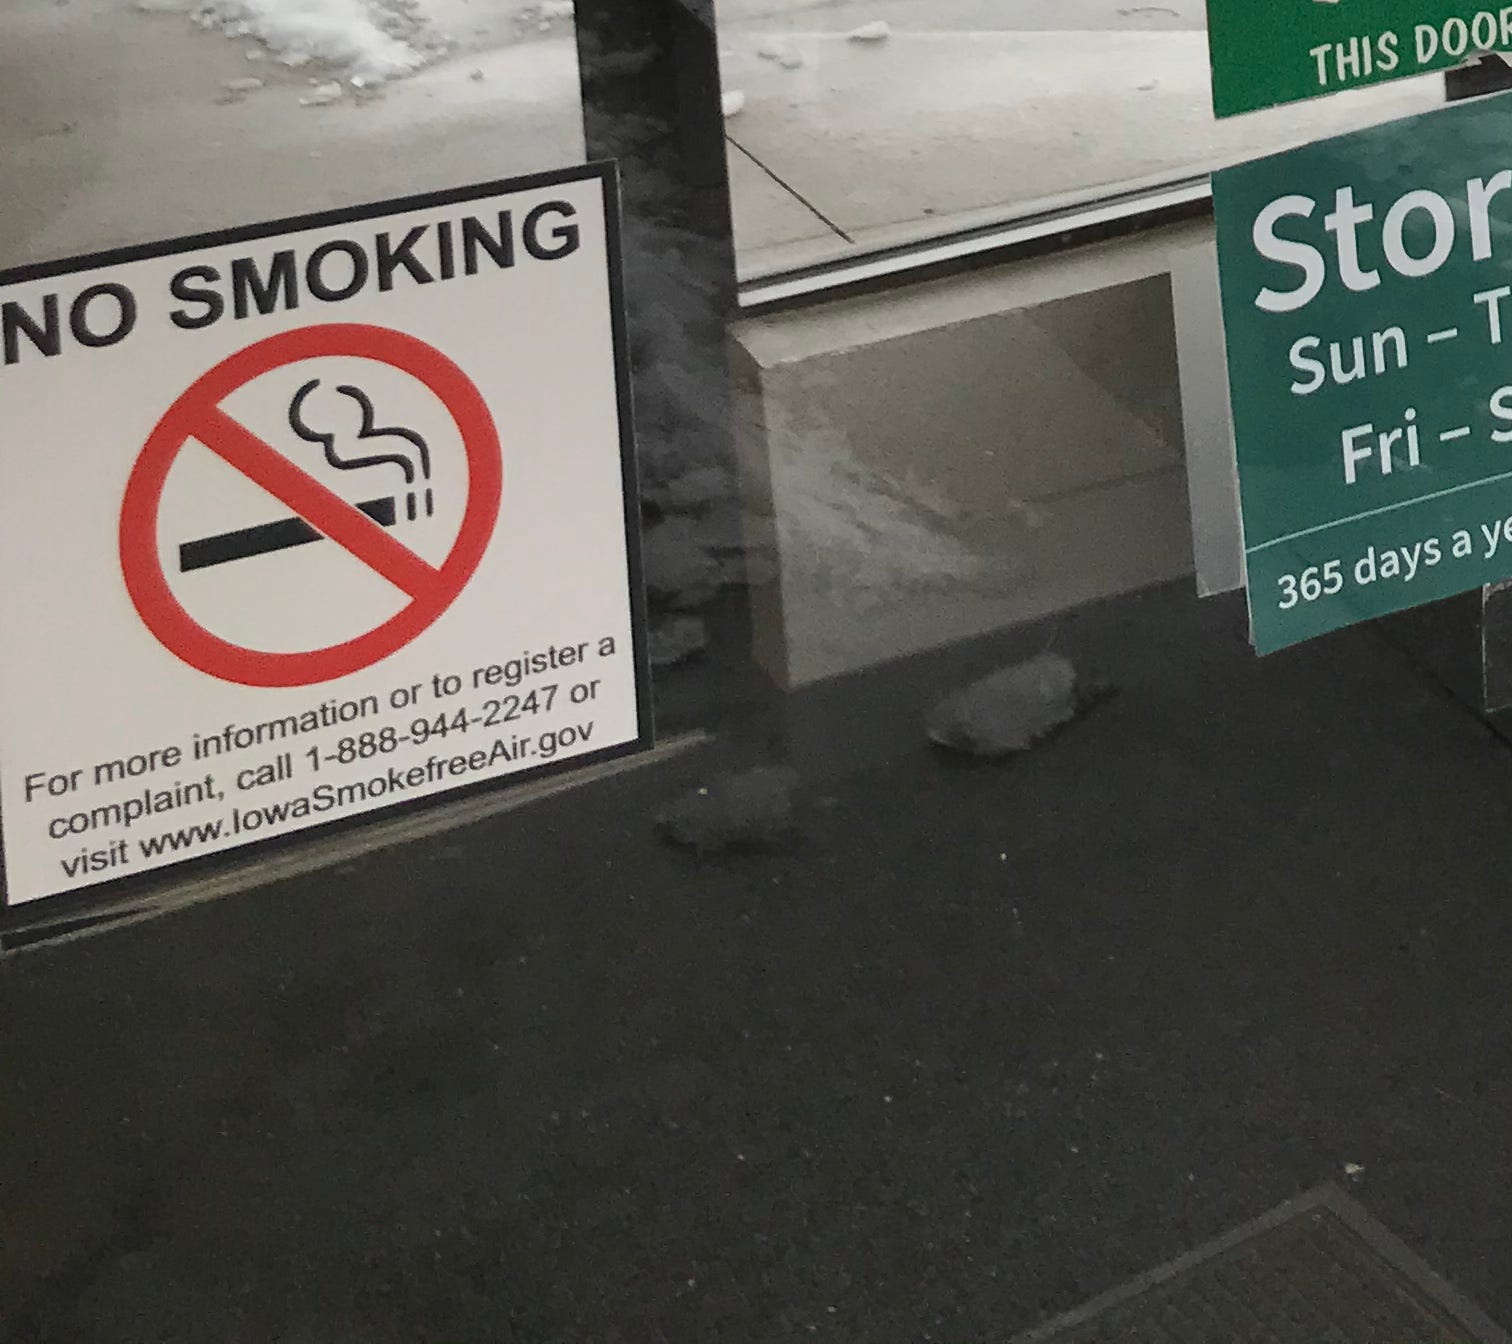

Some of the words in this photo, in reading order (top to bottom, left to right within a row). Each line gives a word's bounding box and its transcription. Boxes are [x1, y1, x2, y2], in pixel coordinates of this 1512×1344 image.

[1310, 34, 1400, 86] THIS
[2, 282, 138, 366] NO
[168, 199, 582, 331] SMOKING
[1289, 322, 1408, 395] Sun
[1339, 408, 1421, 486] Fri
[1276, 560, 1343, 610] 365
[1353, 536, 1441, 589] days
[1451, 529, 1471, 558] a
[23, 770, 80, 803] For
[94, 743, 182, 787] more
[192, 694, 379, 761] information
[390, 682, 423, 710] or
[431, 671, 462, 699] to
[472, 640, 590, 691] register
[597, 635, 617, 658] a
[48, 776, 225, 841] complaint,
[237, 752, 293, 792] call
[305, 685, 558, 772] 1-888-944-2247
[569, 678, 602, 704] or
[60, 845, 130, 880] visit
[138, 719, 596, 861] www.IowaSmokefreeAir.gov
